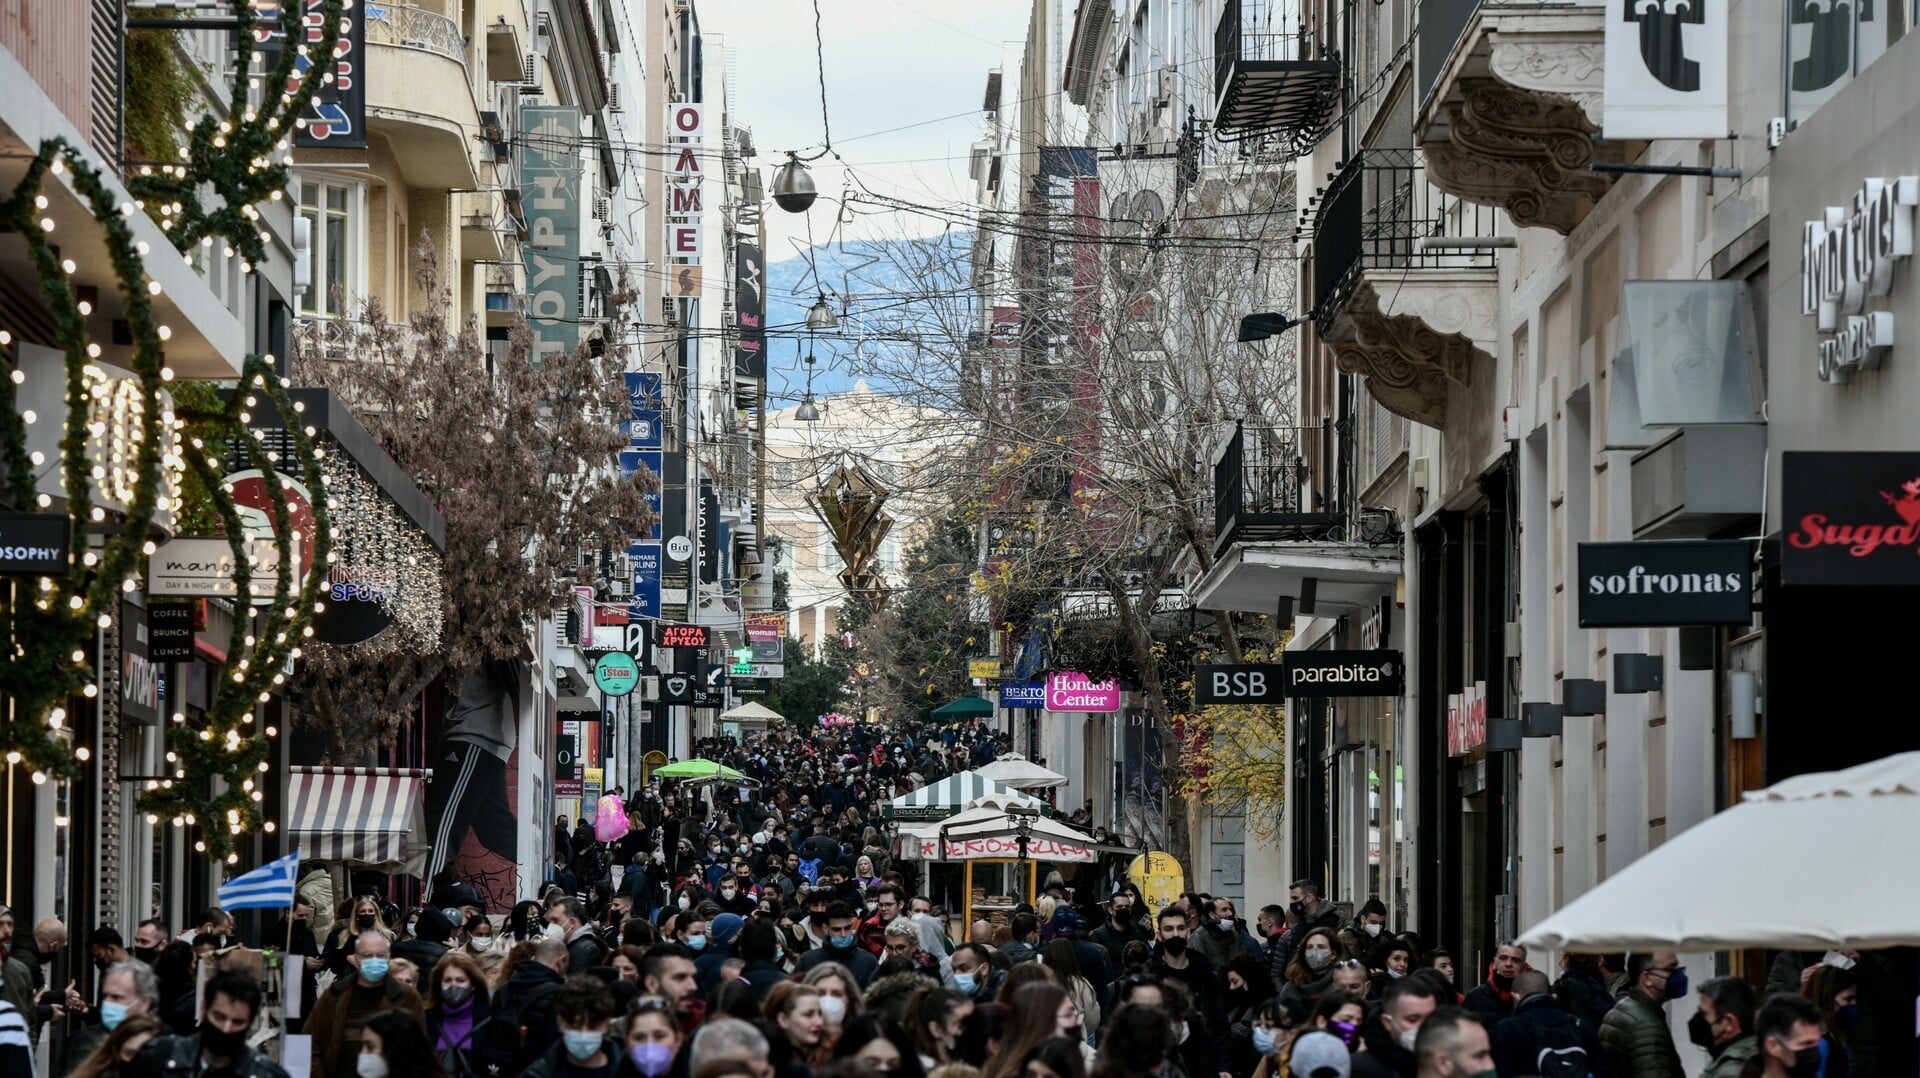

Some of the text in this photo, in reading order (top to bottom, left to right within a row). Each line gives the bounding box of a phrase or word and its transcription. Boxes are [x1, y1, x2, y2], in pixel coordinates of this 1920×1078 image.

[671, 542, 689, 553] Big
[1589, 565, 1741, 595] sofronas
[664, 627, 703, 637] ΑΓΟΡΑ
[747, 629, 777, 637] woman
[662, 637, 706, 646] ΧΡΥΣΟΥ
[153, 648, 190, 656] LUNCH
[1292, 663, 1380, 686] parabita
[1213, 671, 1268, 697] BSB
[1053, 690, 1108, 706] Center
